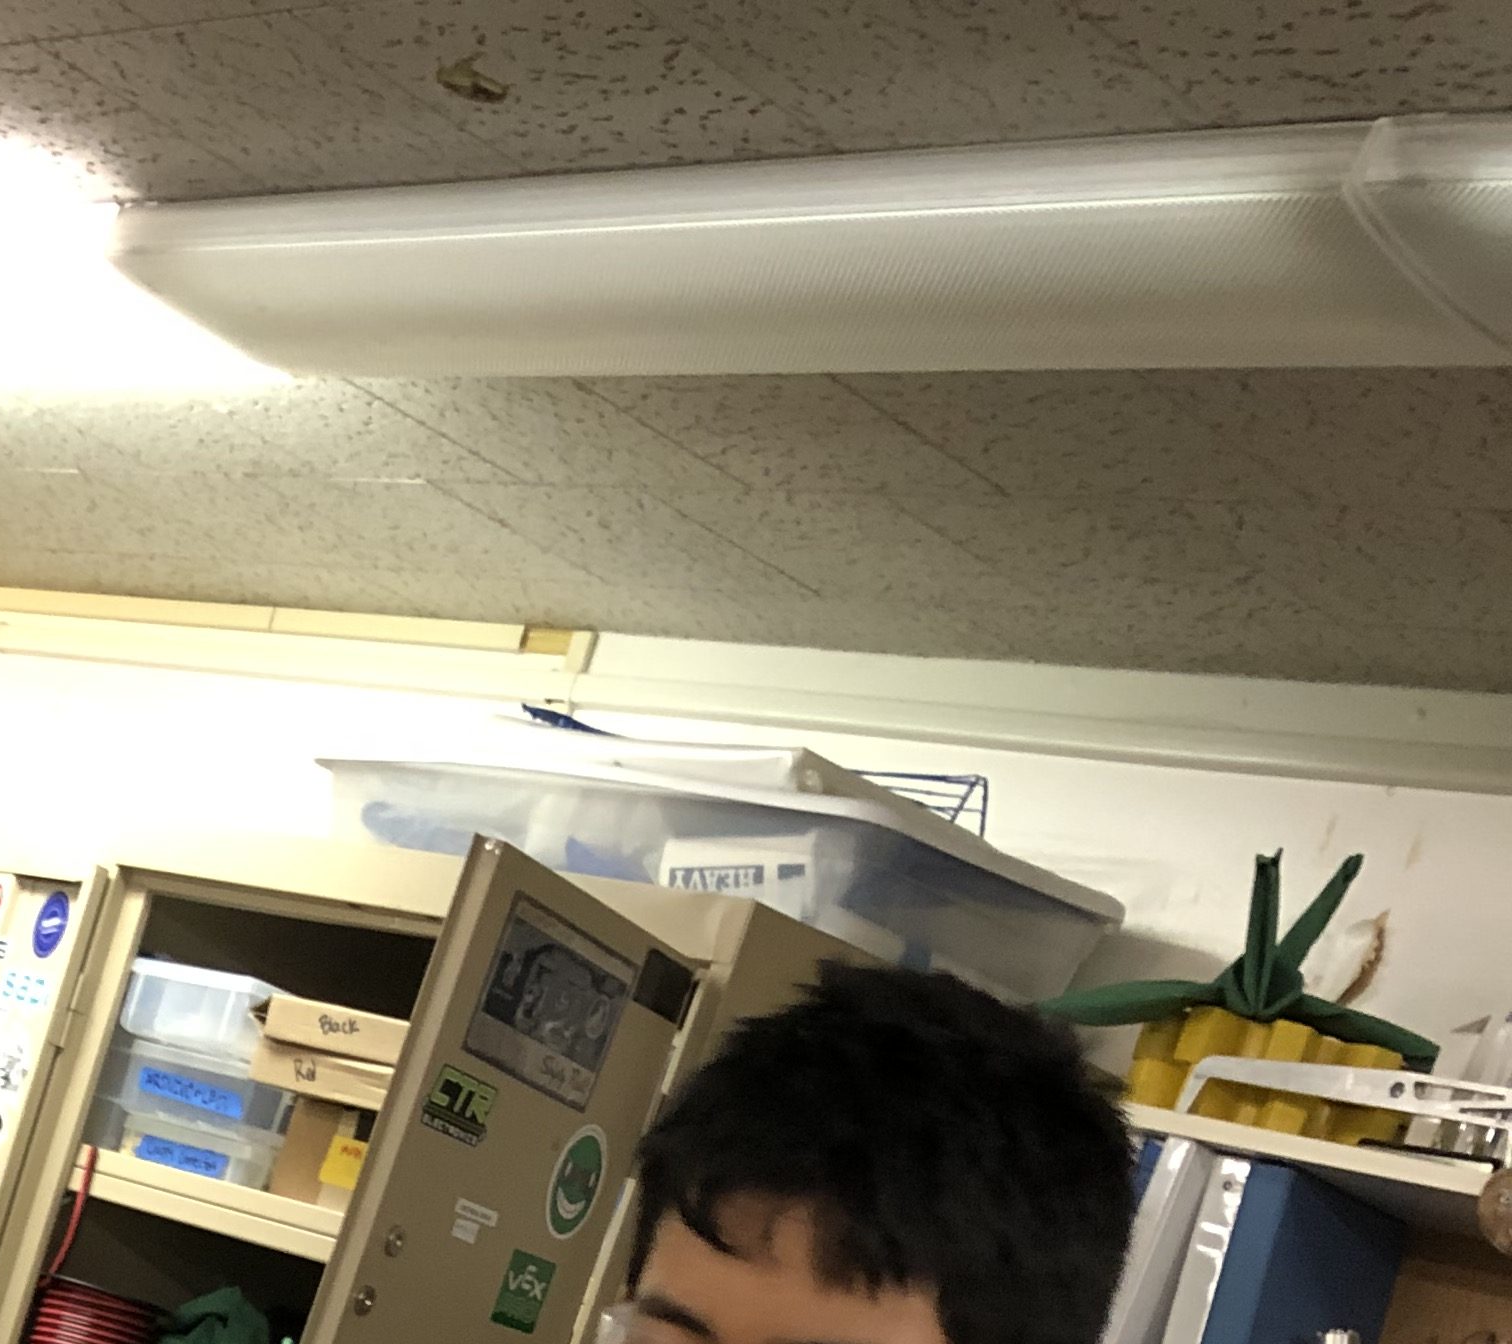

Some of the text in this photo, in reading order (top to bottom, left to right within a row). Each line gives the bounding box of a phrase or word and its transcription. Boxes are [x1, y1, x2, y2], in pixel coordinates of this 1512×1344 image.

[672, 867, 758, 893] HEAVY
[318, 1014, 361, 1036] Black
[428, 1066, 497, 1126] CTR
